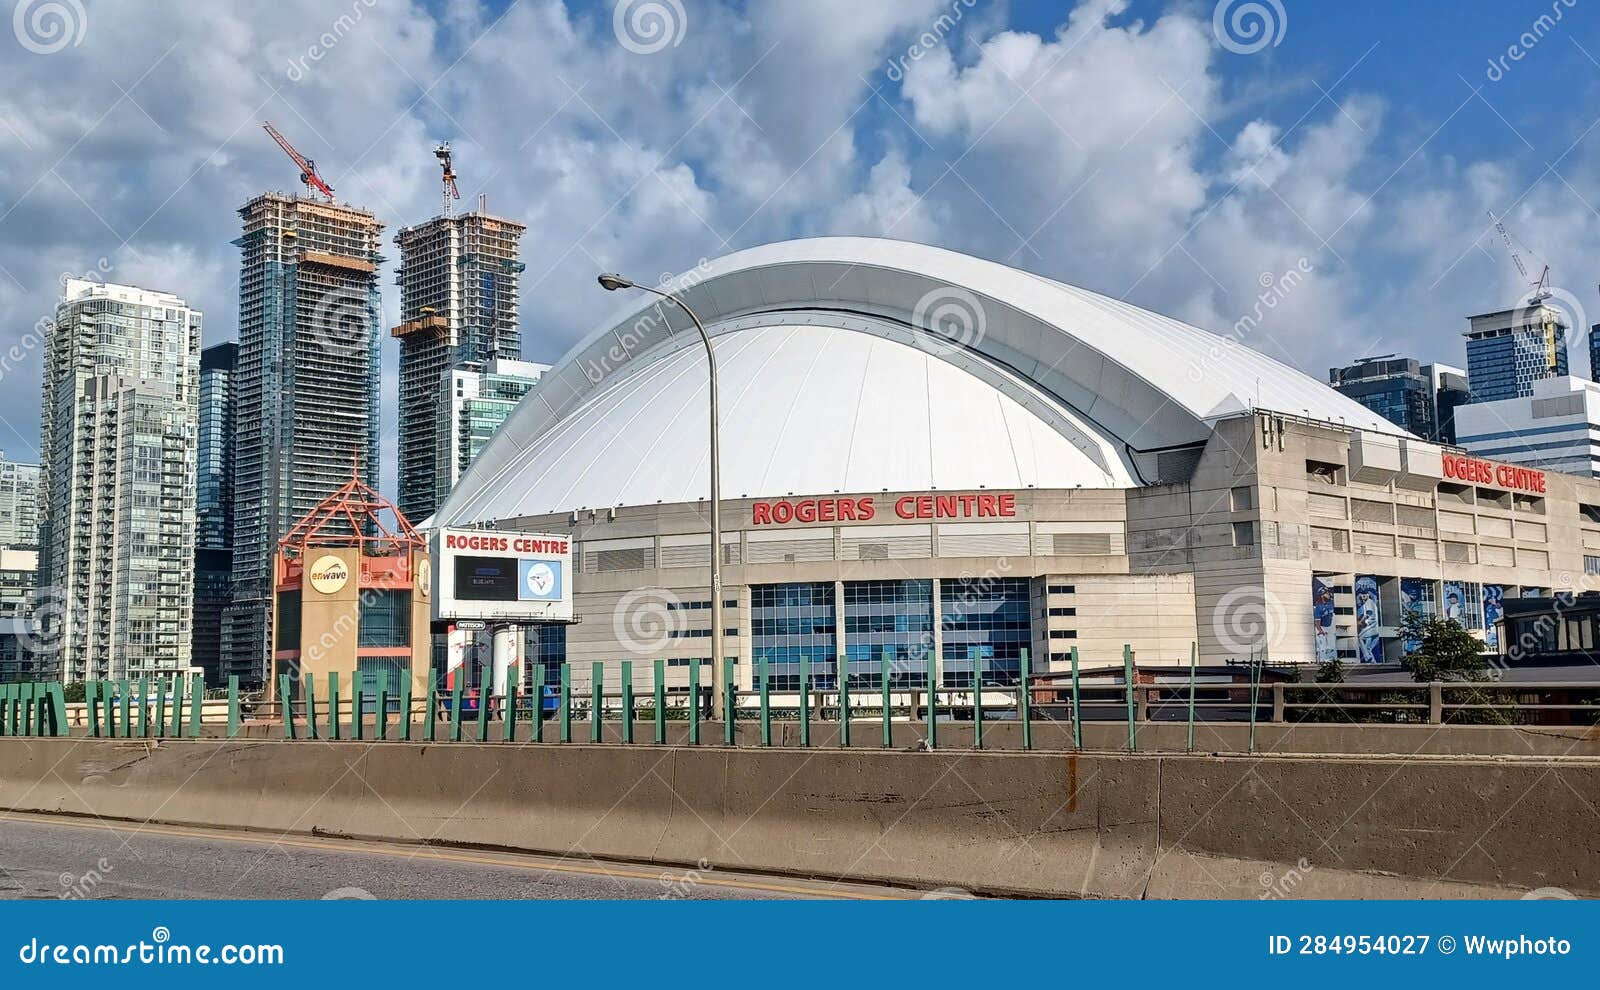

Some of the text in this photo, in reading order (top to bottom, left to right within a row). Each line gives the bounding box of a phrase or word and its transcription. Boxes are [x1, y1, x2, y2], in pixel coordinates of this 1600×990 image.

[1442, 455, 1546, 493] OGERS CENTRE
[753, 493, 1016, 525] ROGERS CENTRE
[446, 534, 568, 555] ROGERS CENTRE
[311, 570, 347, 581] enwave
